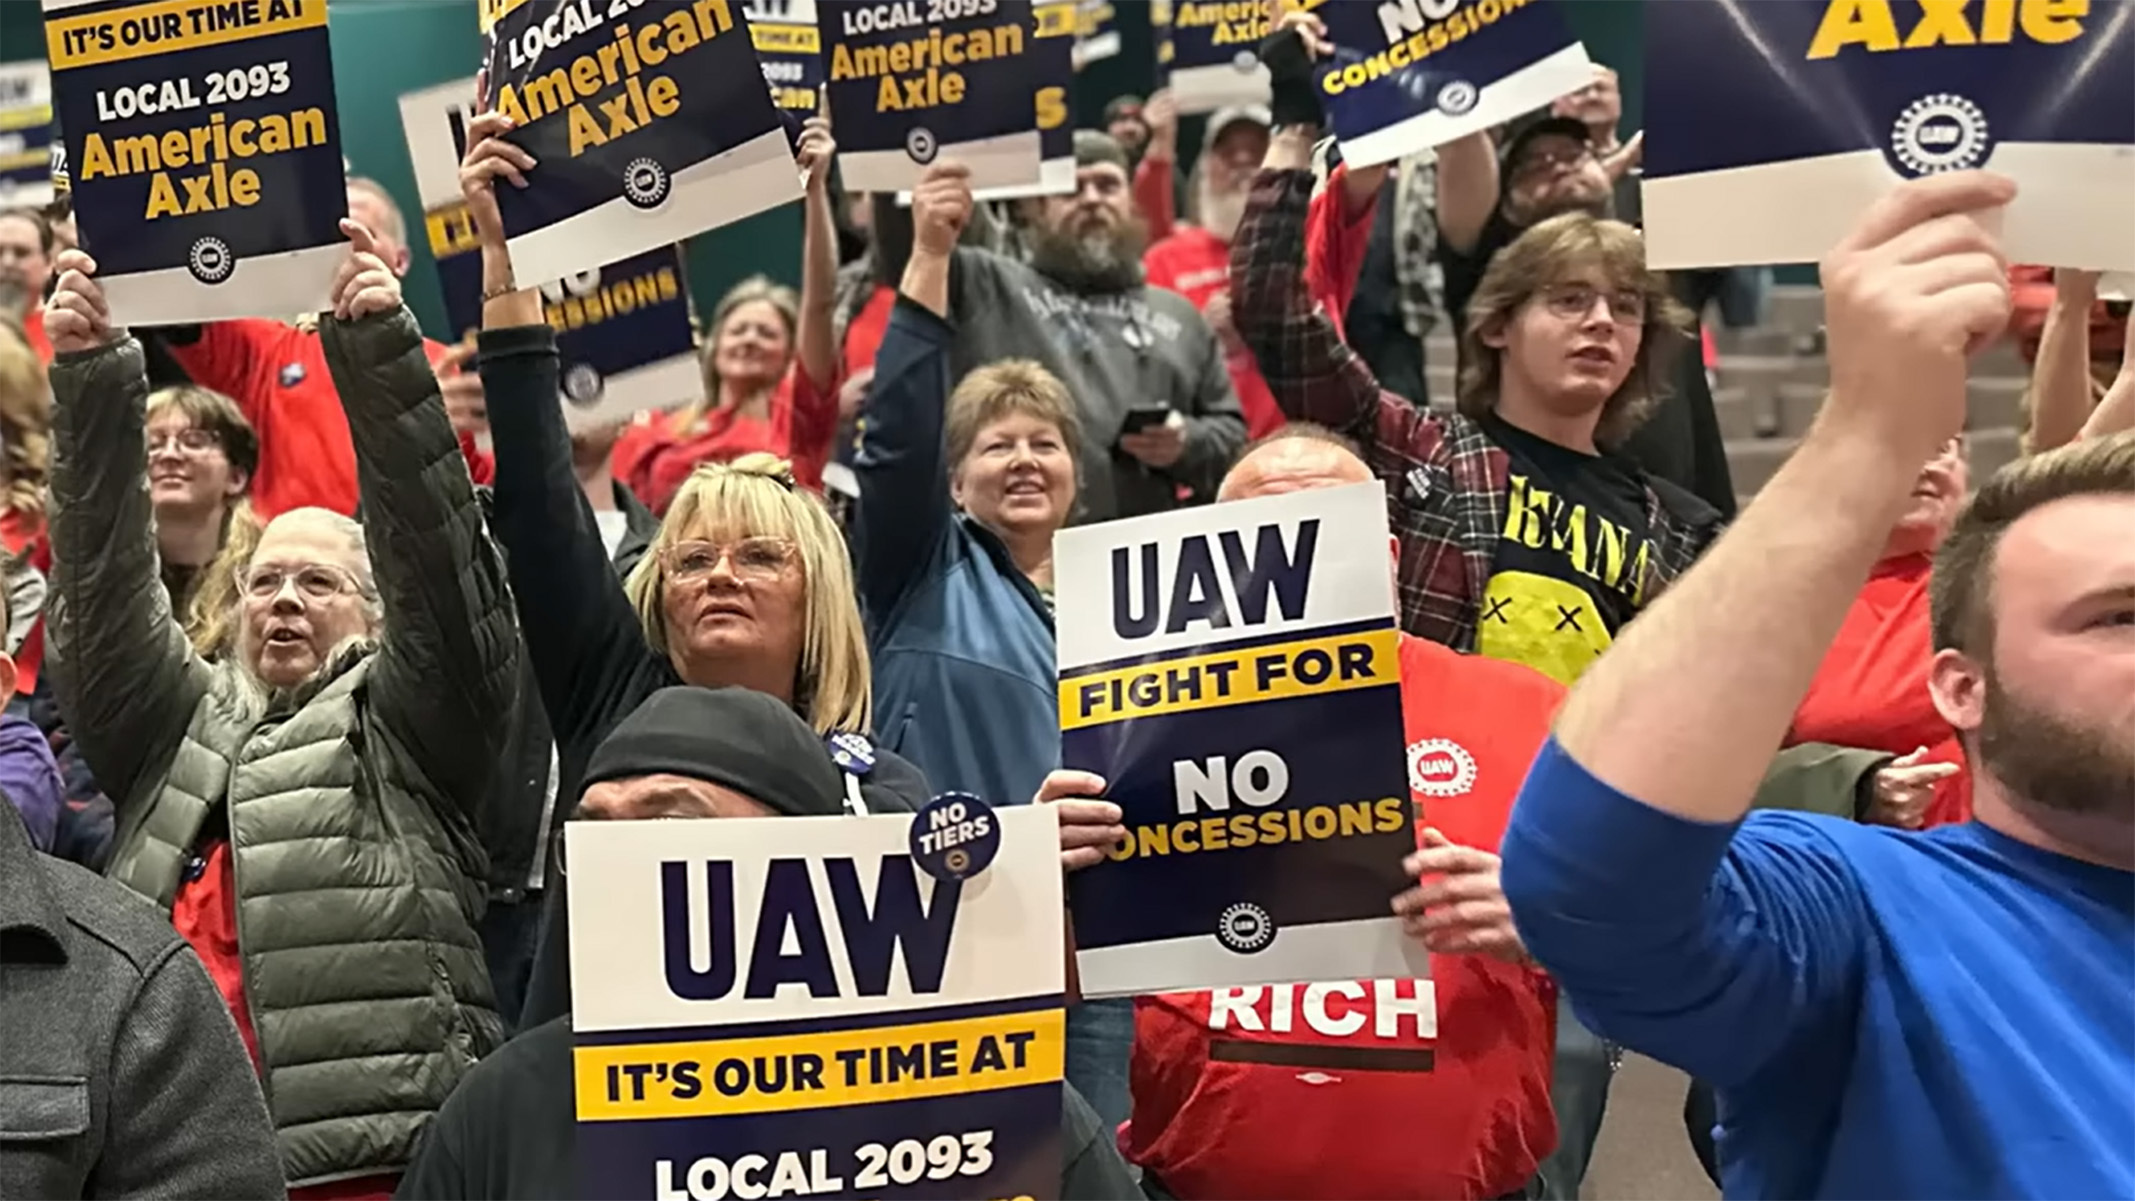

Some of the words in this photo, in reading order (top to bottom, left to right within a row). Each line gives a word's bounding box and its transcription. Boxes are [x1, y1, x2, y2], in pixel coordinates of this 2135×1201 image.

[63, 24, 114, 56] IT'S
[121, 14, 182, 46] OUR
[187, 0, 260, 34] TIME
[508, 0, 603, 69] LOCAL
[843, 1, 923, 35] LOCAL
[1176, 0, 1270, 28] Americ
[498, 0, 733, 127] American
[830, 23, 1023, 81] American
[1322, 0, 1530, 95] CONCESSION
[97, 78, 200, 121] LOCAL
[206, 61, 291, 105] 2093
[568, 76, 681, 157] Axle
[876, 67, 965, 113] Axle
[80, 106, 327, 181] American
[145, 163, 261, 220] Axle
[1112, 519, 1320, 640] UAW
[1080, 660, 1239, 718] FIGHT
[1256, 643, 1376, 692] FOR
[1173, 749, 1289, 815] NO
[1420, 758, 1454, 775] UAW
[918, 815, 990, 855] TIERS
[929, 802, 967, 830] NO
[1107, 798, 1404, 861] ONCESSIONS
[661, 854, 963, 1001] UAW
[1208, 978, 1438, 1039] RICH
[606, 1061, 702, 1101] IT'S
[713, 1053, 825, 1096] OUR
[836, 1040, 957, 1084] TIME
[972, 1031, 1036, 1074] AT
[655, 1148, 843, 1201] LOCAL
[853, 1130, 994, 1190] 2093
